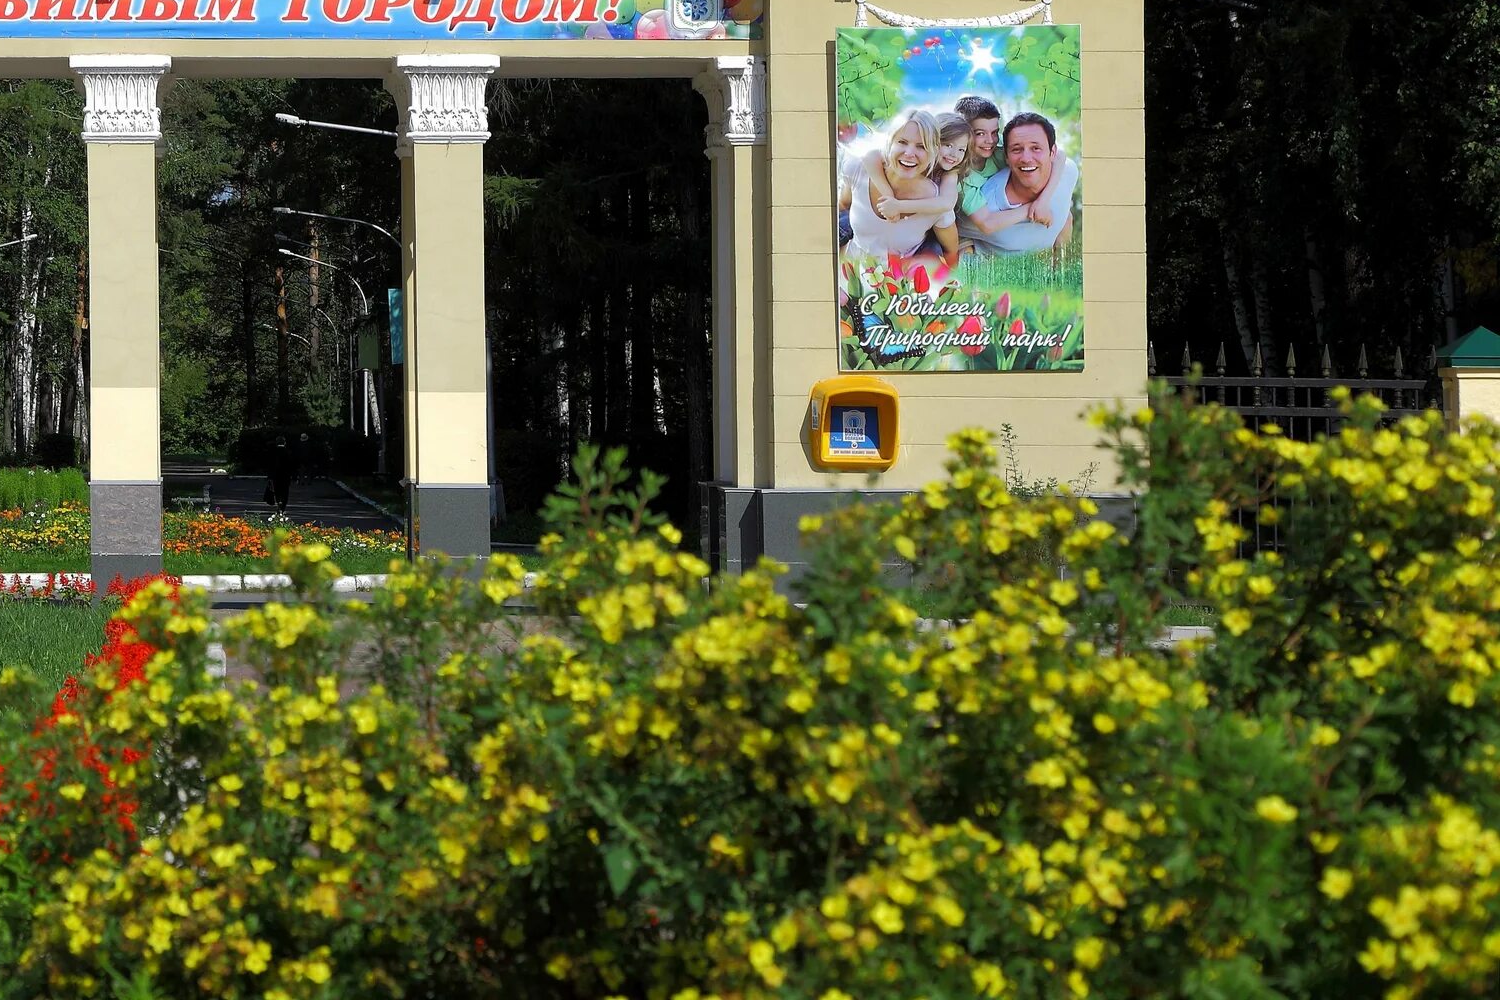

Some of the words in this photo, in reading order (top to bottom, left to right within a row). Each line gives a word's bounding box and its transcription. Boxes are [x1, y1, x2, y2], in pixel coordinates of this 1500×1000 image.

[861, 294, 878, 316] С
[885, 294, 992, 318] Юбилеем,
[860, 325, 991, 352] Природный
[1002, 324, 1072, 352] парк!
